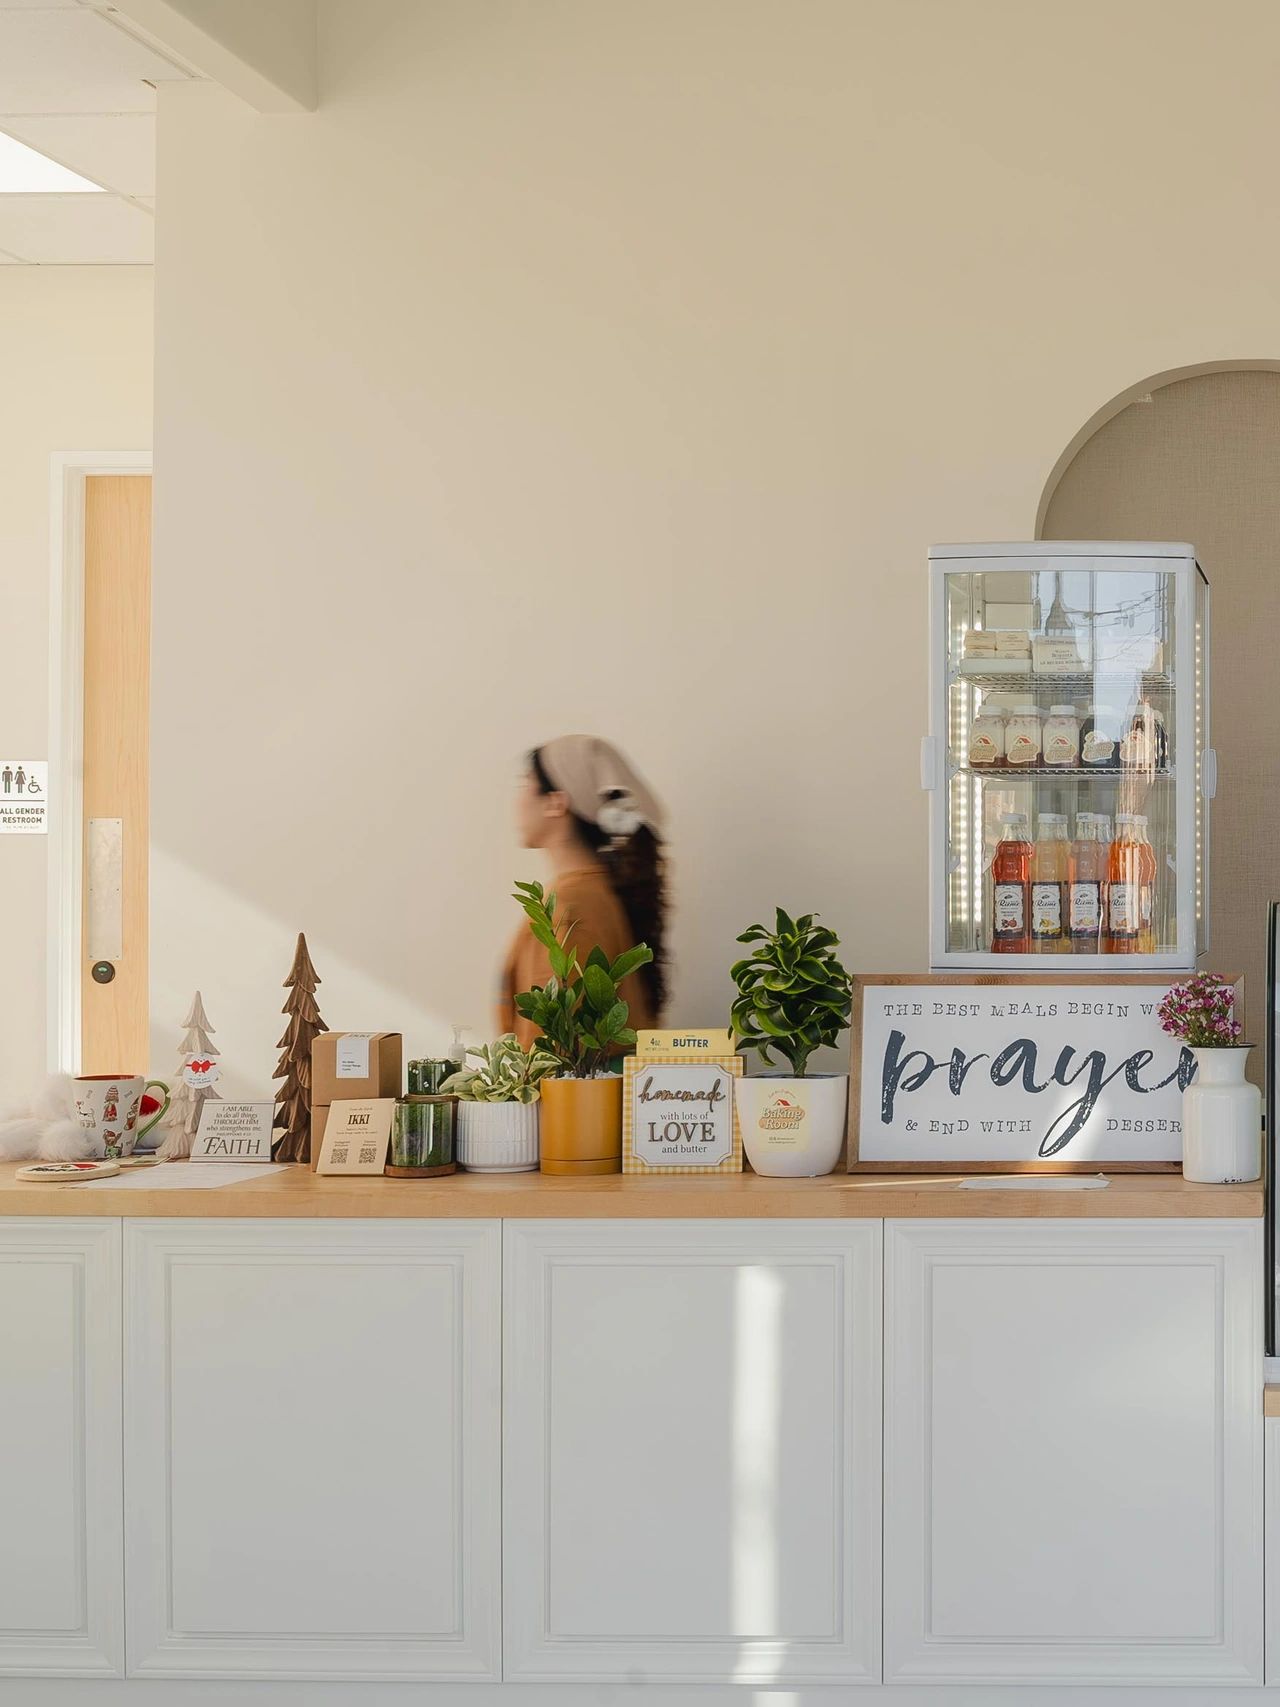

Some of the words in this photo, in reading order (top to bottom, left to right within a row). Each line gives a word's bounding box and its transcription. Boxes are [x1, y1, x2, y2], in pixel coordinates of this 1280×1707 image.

[884, 1004, 922, 1016] THE
[933, 1003, 980, 1016] BEST
[991, 1002, 1058, 1017] MEALS
[1068, 1002, 1129, 1018] BEGIN
[672, 1038, 709, 1047] BUTTER
[638, 1076, 726, 1112] homemade
[881, 1030, 1198, 1158] prayer
[348, 1114, 370, 1125] IKKI
[660, 1112, 679, 1120] with
[682, 1112, 697, 1120] lots
[700, 1112, 709, 1120] of
[762, 1107, 802, 1121] Baking
[648, 1122, 716, 1142] LOVE
[765, 1119, 800, 1130] Room
[905, 1119, 918, 1131] &
[929, 1120, 969, 1134] END
[980, 1120, 1032, 1132] WITH
[1107, 1118, 1182, 1132] DESSER
[203, 1137, 260, 1154] FAITH
[662, 1145, 678, 1153] and
[681, 1145, 707, 1153] butter
